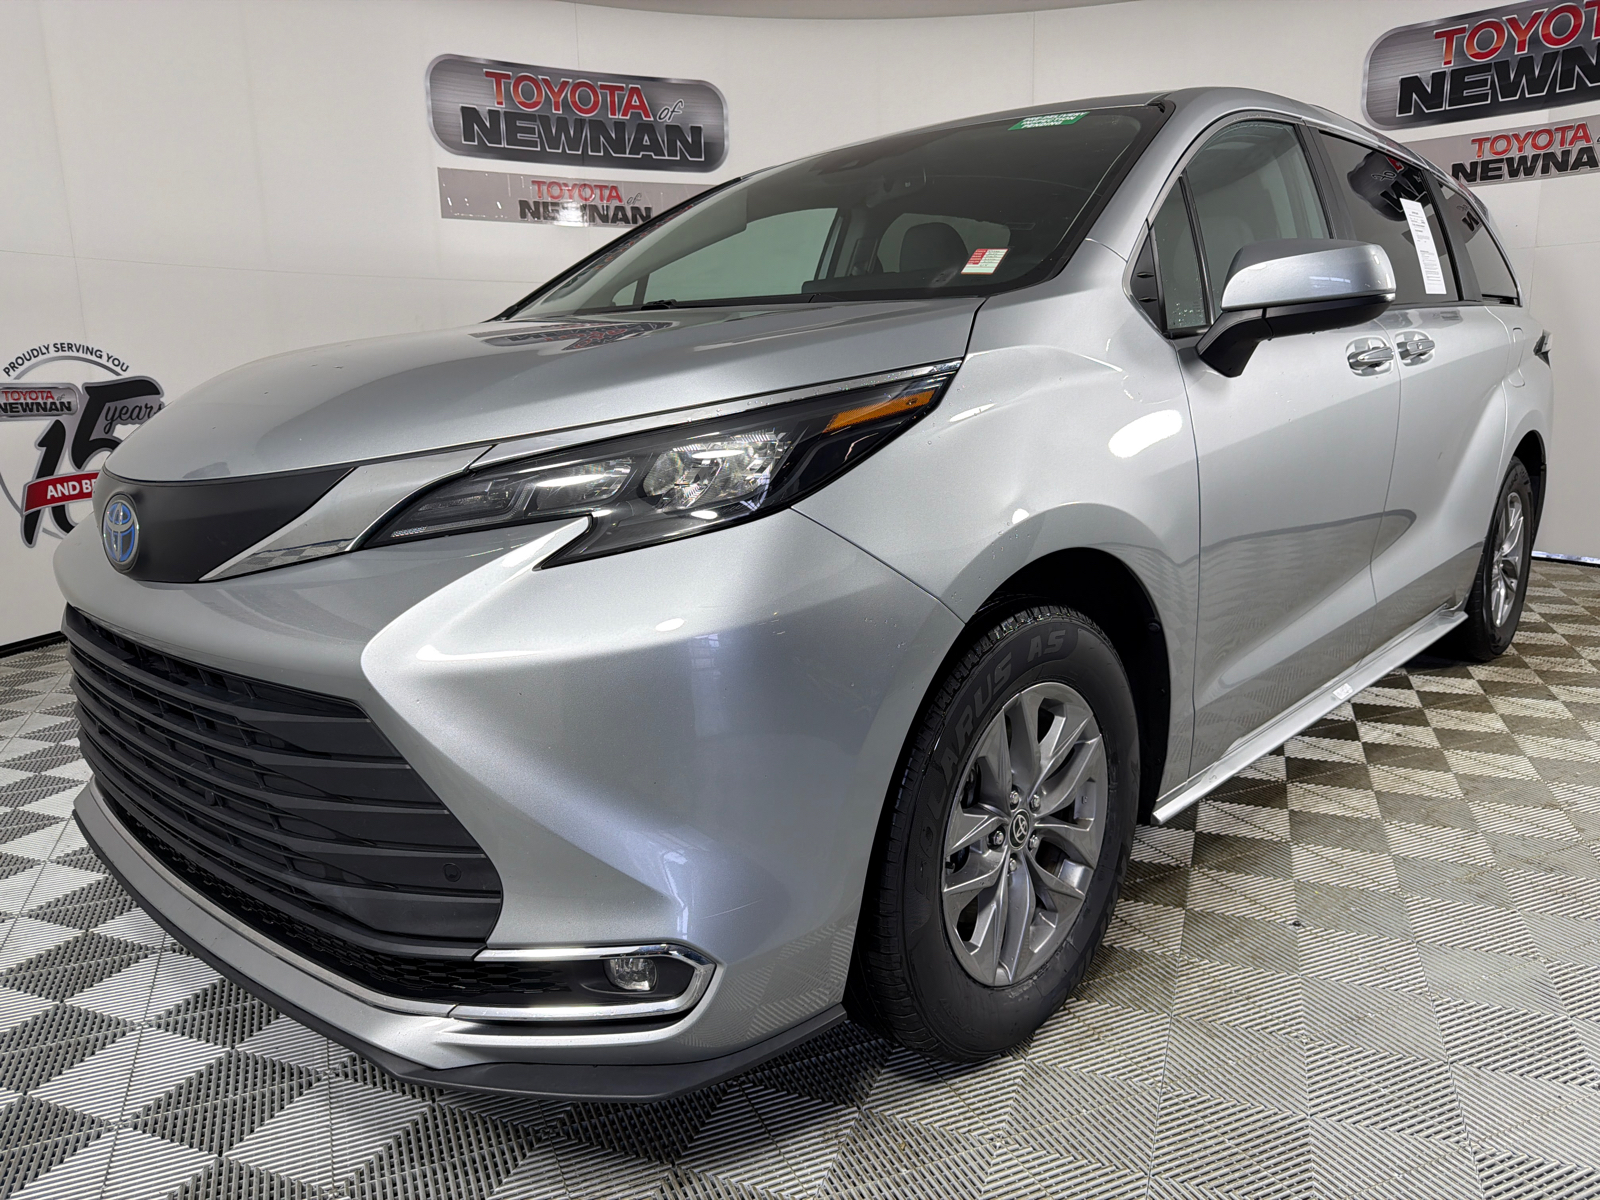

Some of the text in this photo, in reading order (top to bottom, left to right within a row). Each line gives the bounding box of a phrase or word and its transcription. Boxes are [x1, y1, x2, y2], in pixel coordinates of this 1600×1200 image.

[484, 69, 684, 122] TOYOTA of
[460, 105, 704, 161] NEWNAN
[1471, 123, 1592, 158] TOYOTA
[1452, 146, 1600, 183] NEWNA
[531, 179, 642, 206] TOYOTA of
[518, 199, 653, 225] NENAN
[3, 342, 130, 377] PROUDLY SERVING YOU
[0, 401, 72, 414] NEWNAN
[1, 390, 55, 402] TOYOTA
[46, 481, 81, 500] AND
[1026, 629, 1067, 663] AS
